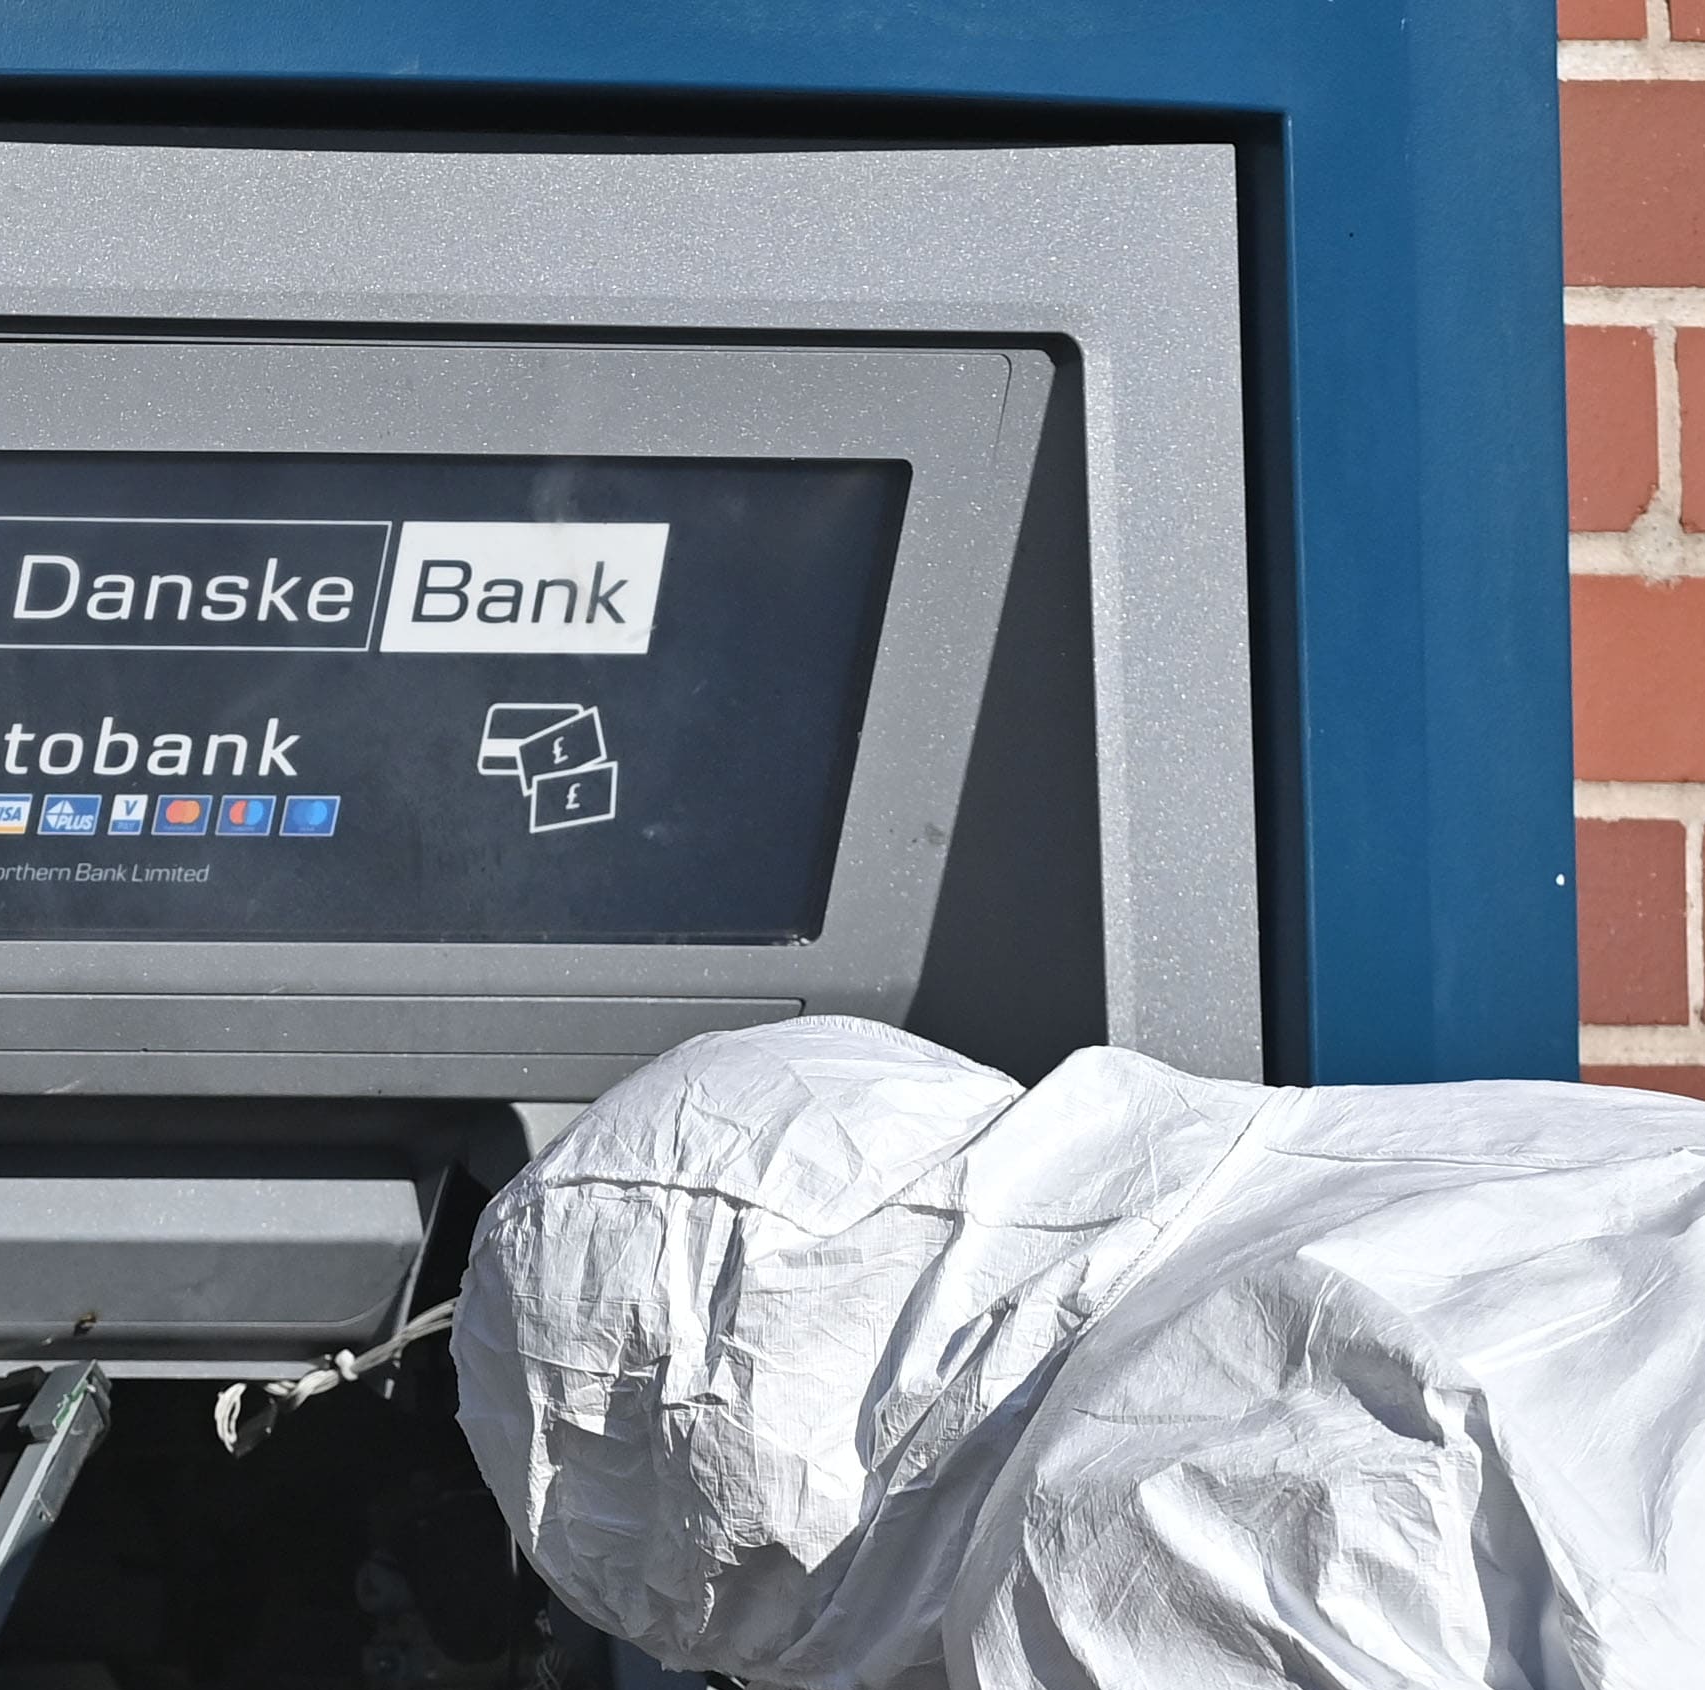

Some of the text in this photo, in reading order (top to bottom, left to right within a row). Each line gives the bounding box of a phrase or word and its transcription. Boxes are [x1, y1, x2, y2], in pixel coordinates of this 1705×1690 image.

[12, 554, 630, 625] Danske Bank
[123, 800, 138, 816] V
[55, 814, 95, 831] PLUS
[75, 863, 127, 883] Bank
[132, 863, 210, 883] Limited
